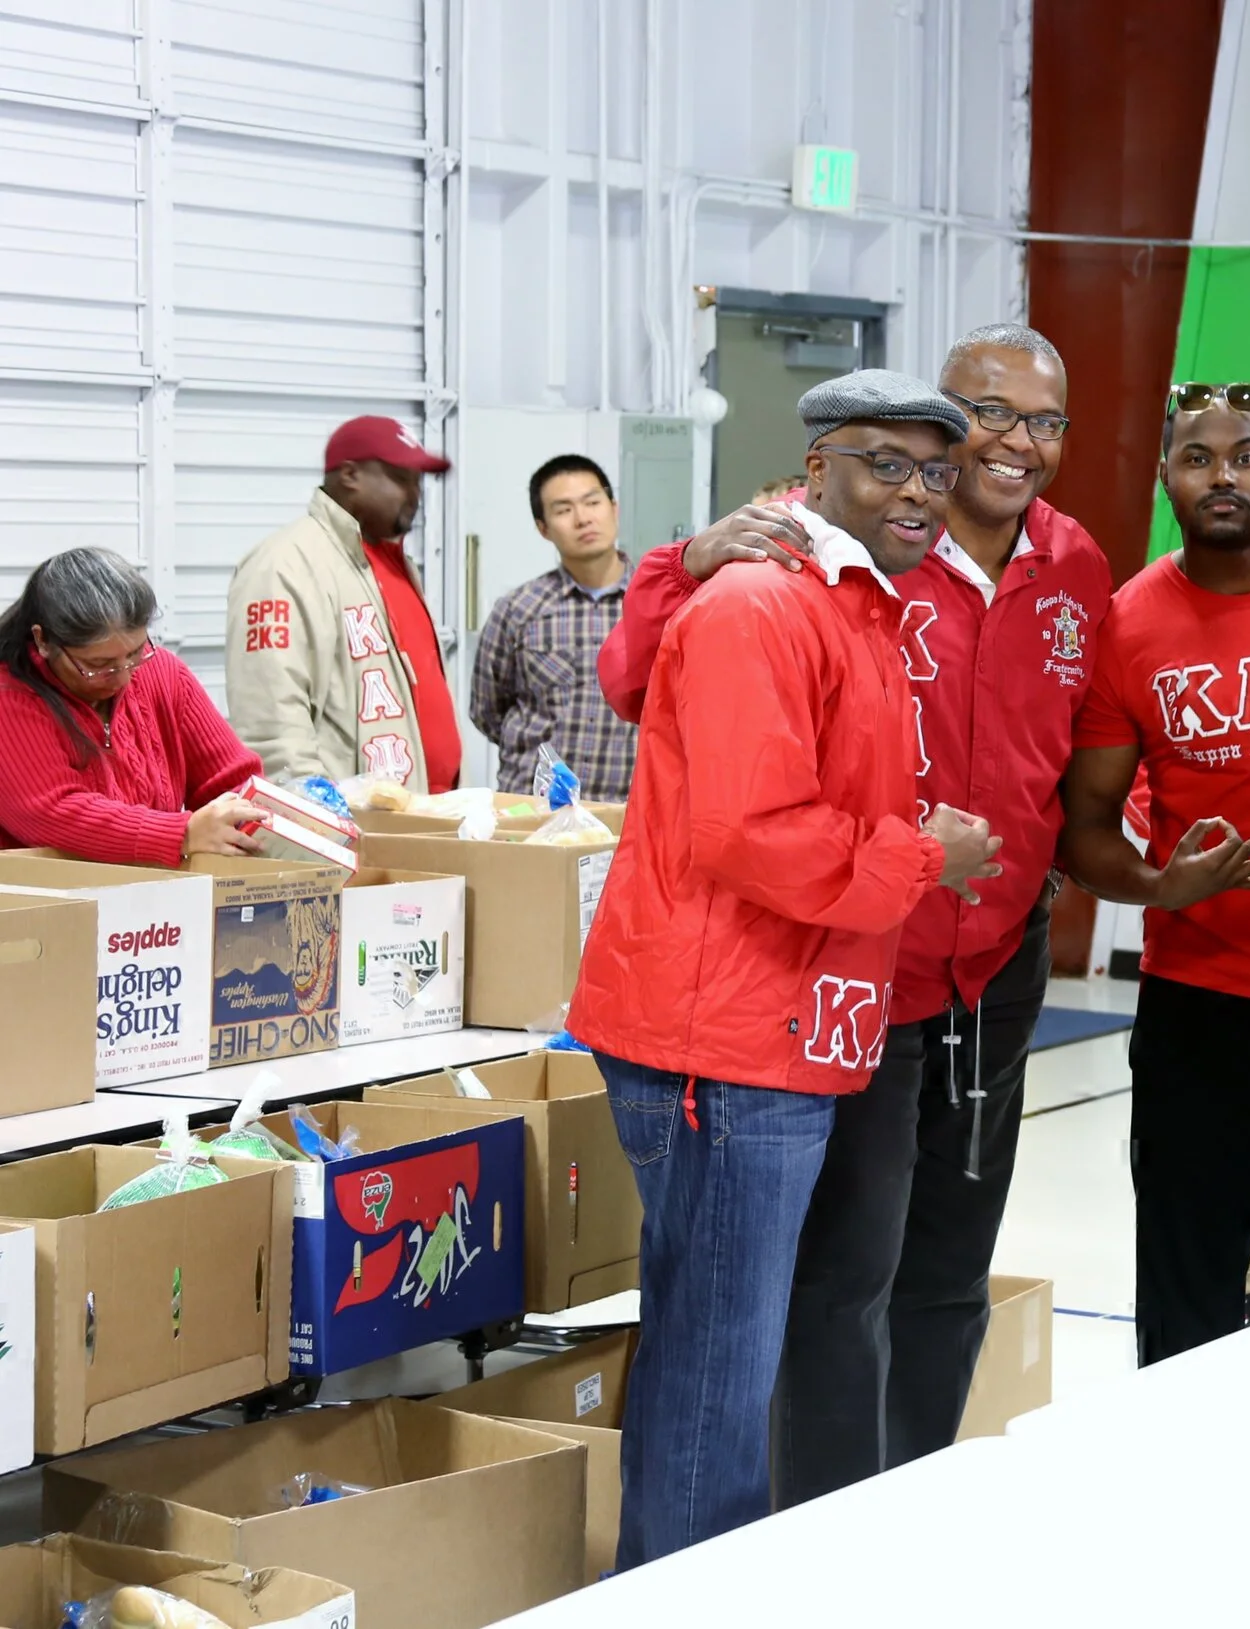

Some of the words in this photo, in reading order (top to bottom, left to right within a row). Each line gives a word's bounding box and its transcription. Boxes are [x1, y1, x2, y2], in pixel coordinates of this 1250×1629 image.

[246, 600, 290, 625] SPR
[246, 626, 290, 652] 2K3
[1042, 630, 1051, 640] 19
[107, 922, 181, 957] apples
[221, 981, 254, 998] Apples
[231, 992, 288, 1009] Washington
[97, 1001, 181, 1045] King's
[151, 1041, 178, 1049] PRODUCE
[210, 1012, 339, 1061] SNO-CHIEF
[364, 1184, 391, 1198] enza
[300, 1323, 312, 1334] CAT
[300, 1352, 313, 1365] ONE
